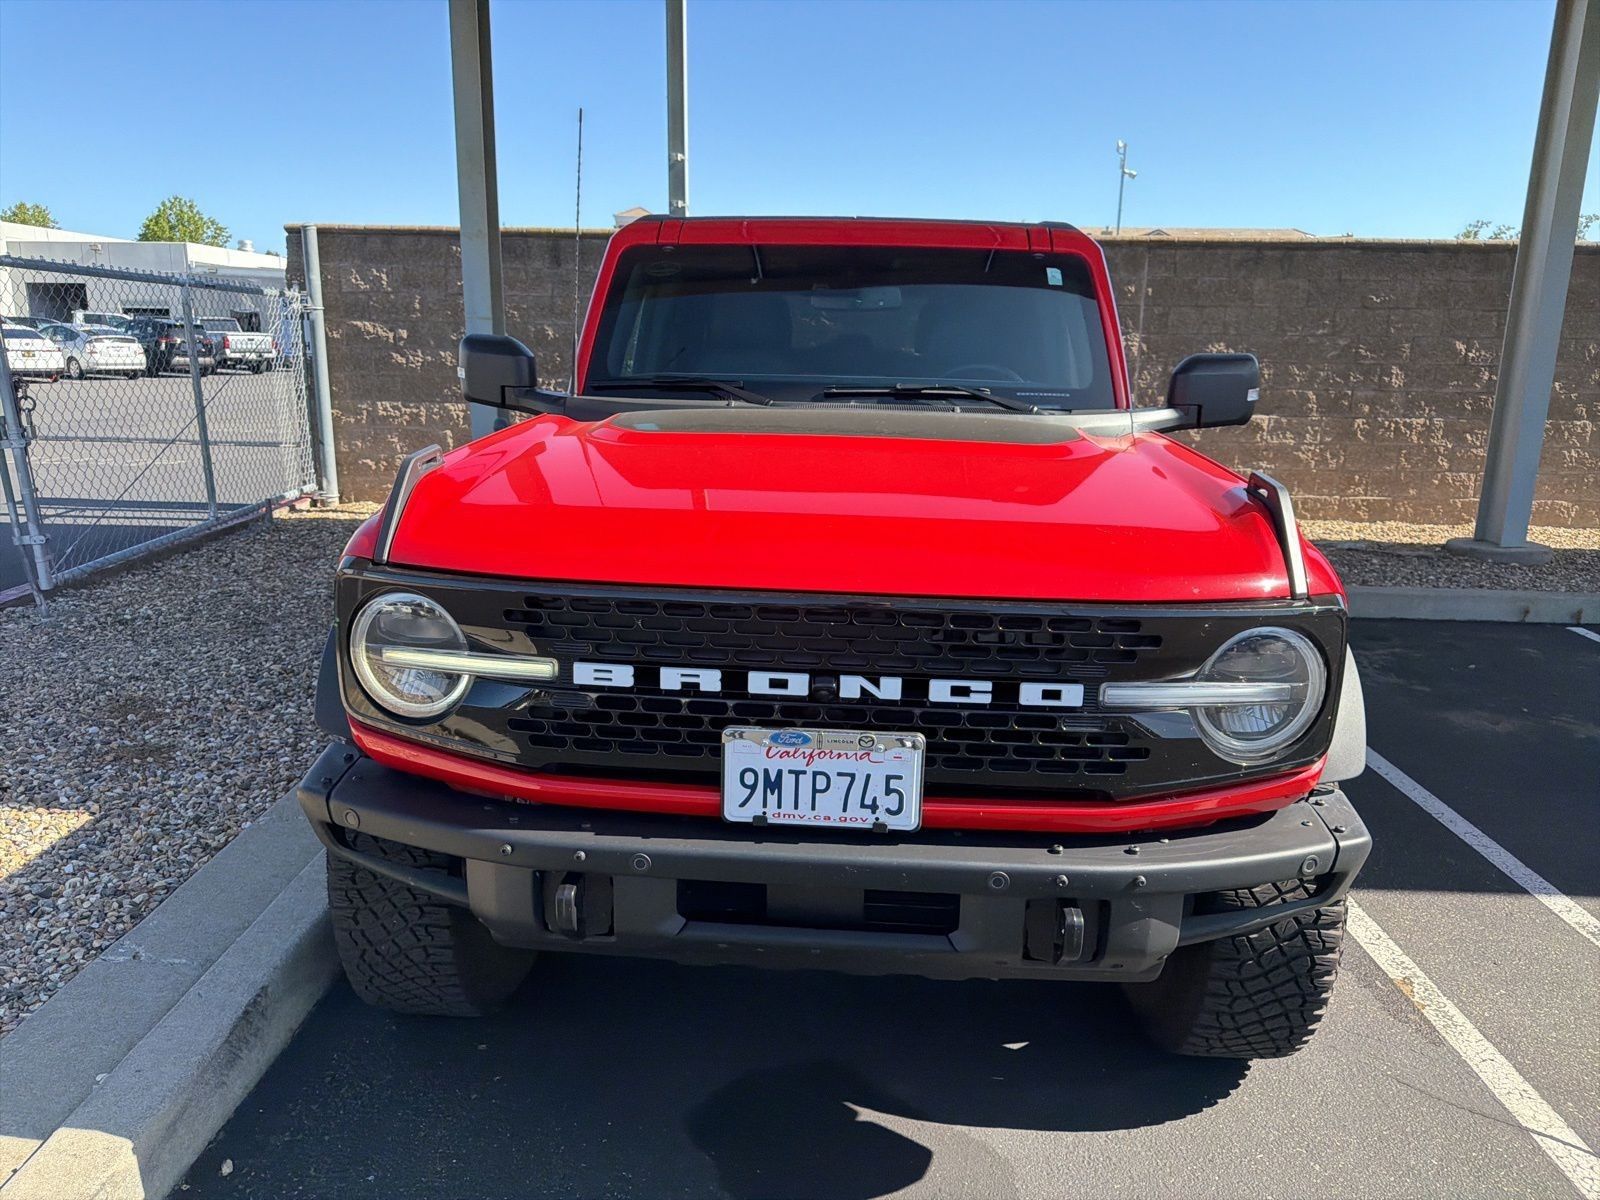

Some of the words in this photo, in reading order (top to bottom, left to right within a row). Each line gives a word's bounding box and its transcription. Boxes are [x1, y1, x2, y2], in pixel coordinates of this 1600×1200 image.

[573, 661, 1084, 707] BRONCO
[777, 733, 803, 744] Ford
[765, 746, 885, 767] California
[738, 767, 905, 816] 9MTP745
[771, 811, 869, 823] dmv.ca.gov
